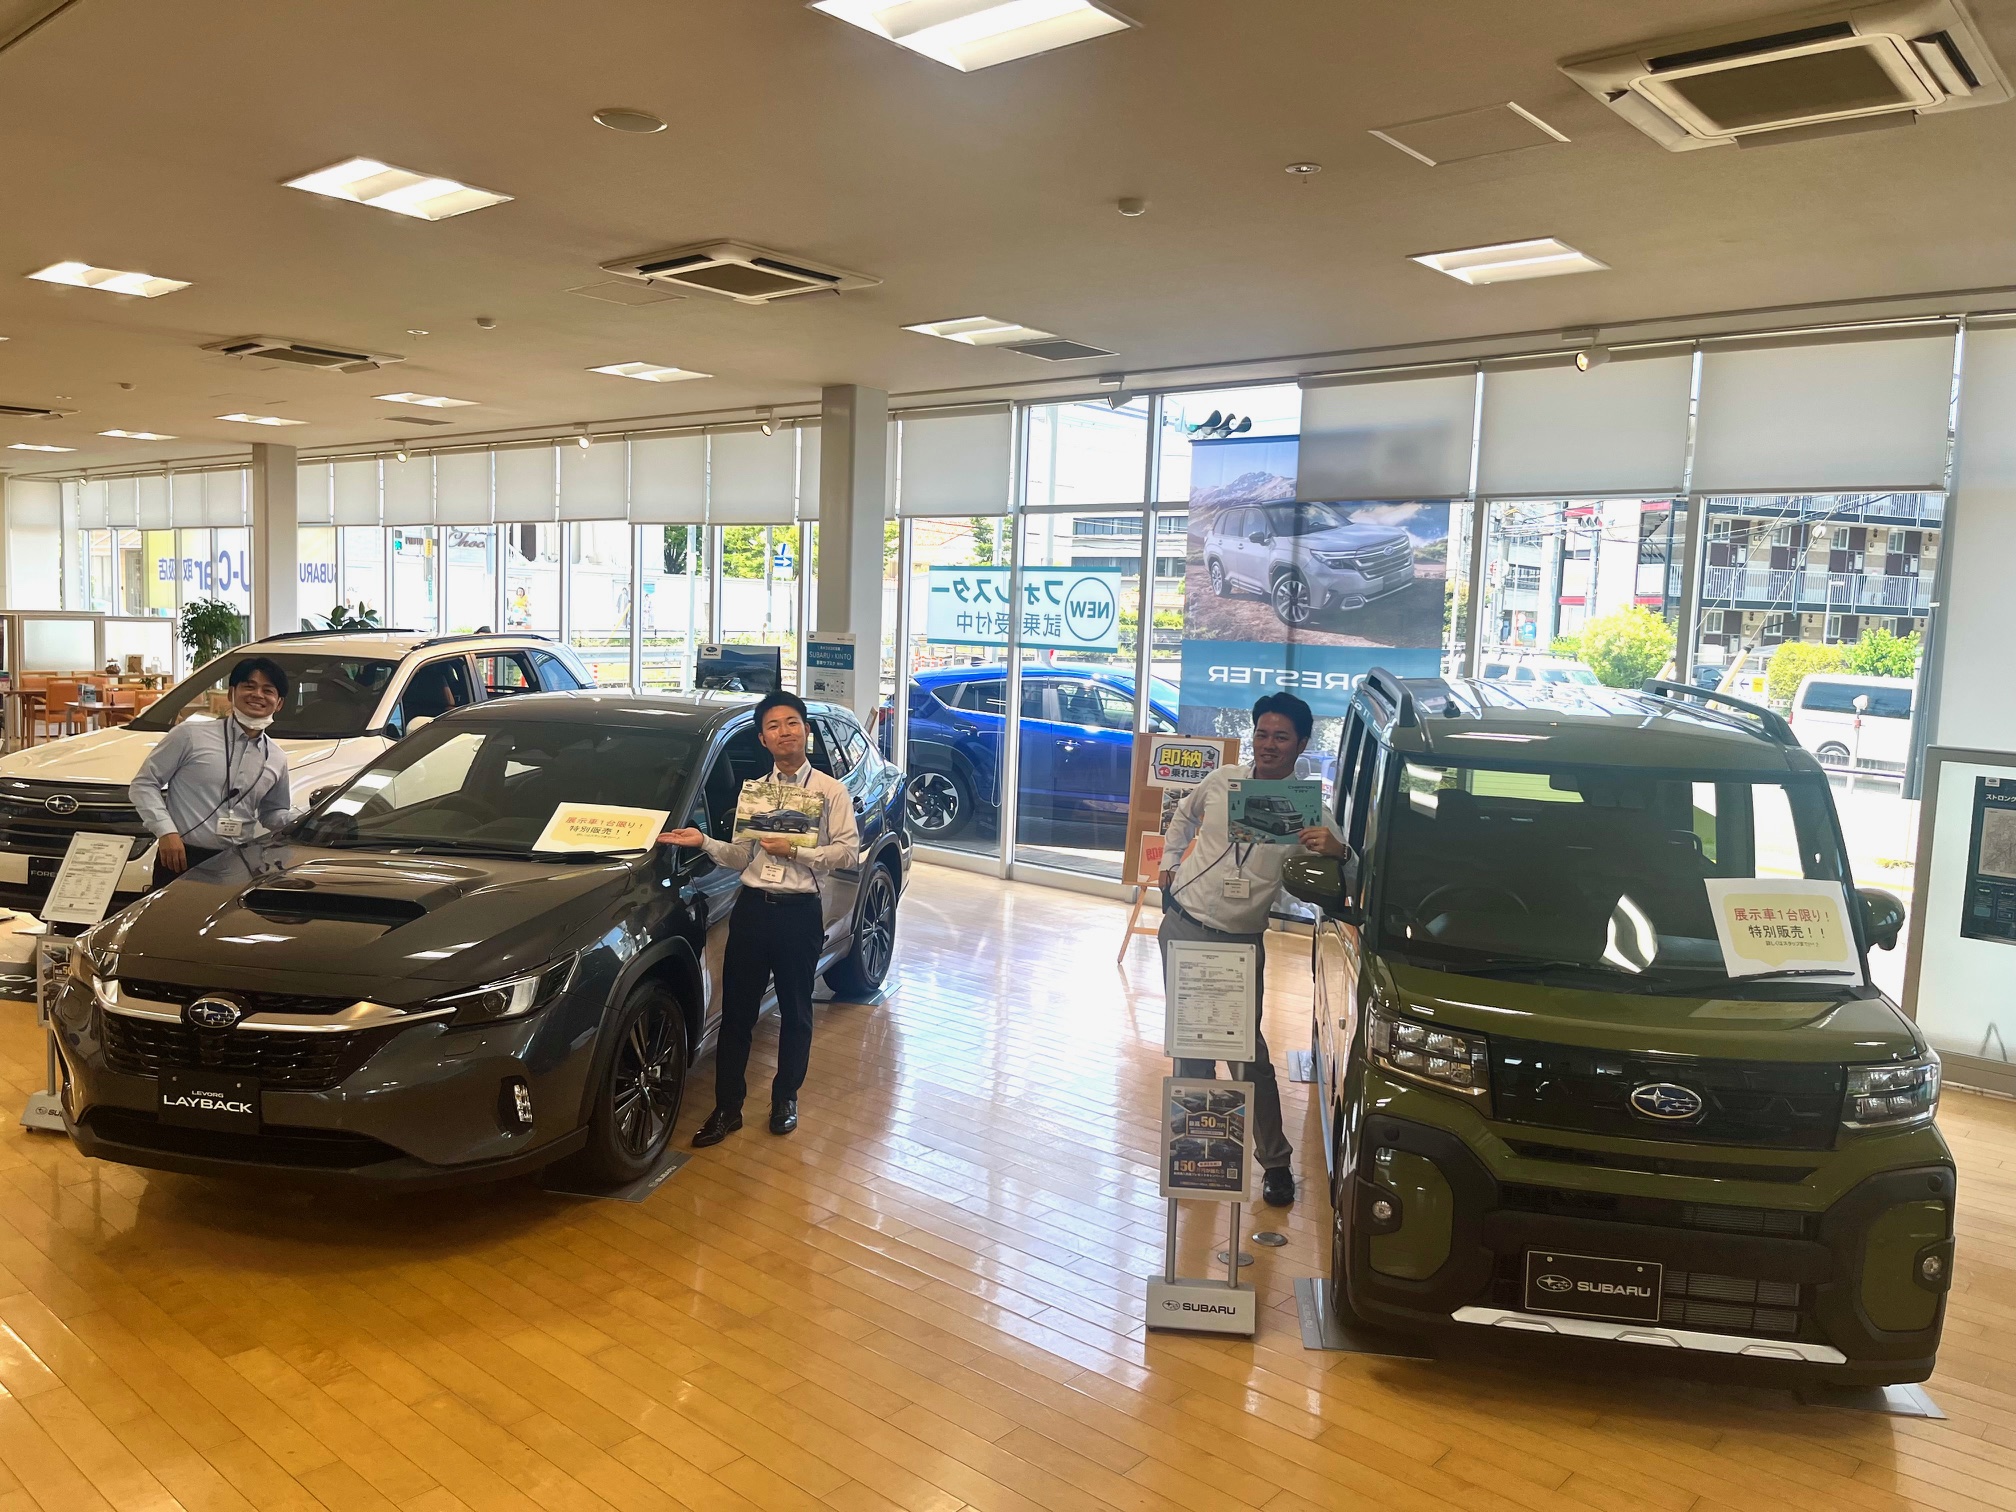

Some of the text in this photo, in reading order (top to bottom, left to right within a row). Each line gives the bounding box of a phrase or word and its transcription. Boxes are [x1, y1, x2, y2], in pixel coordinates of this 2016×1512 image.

[808, 650, 831, 660] SUBARU
[835, 653, 852, 661] KINTO
[1159, 748, 1203, 768] 即納
[30, 870, 59, 878] FORE
[191, 1090, 224, 1099] LEVORG
[163, 1094, 253, 1114] LAYBACK
[1577, 1281, 1651, 1297] SUBARU
[1182, 1302, 1236, 1315] SUBARU
